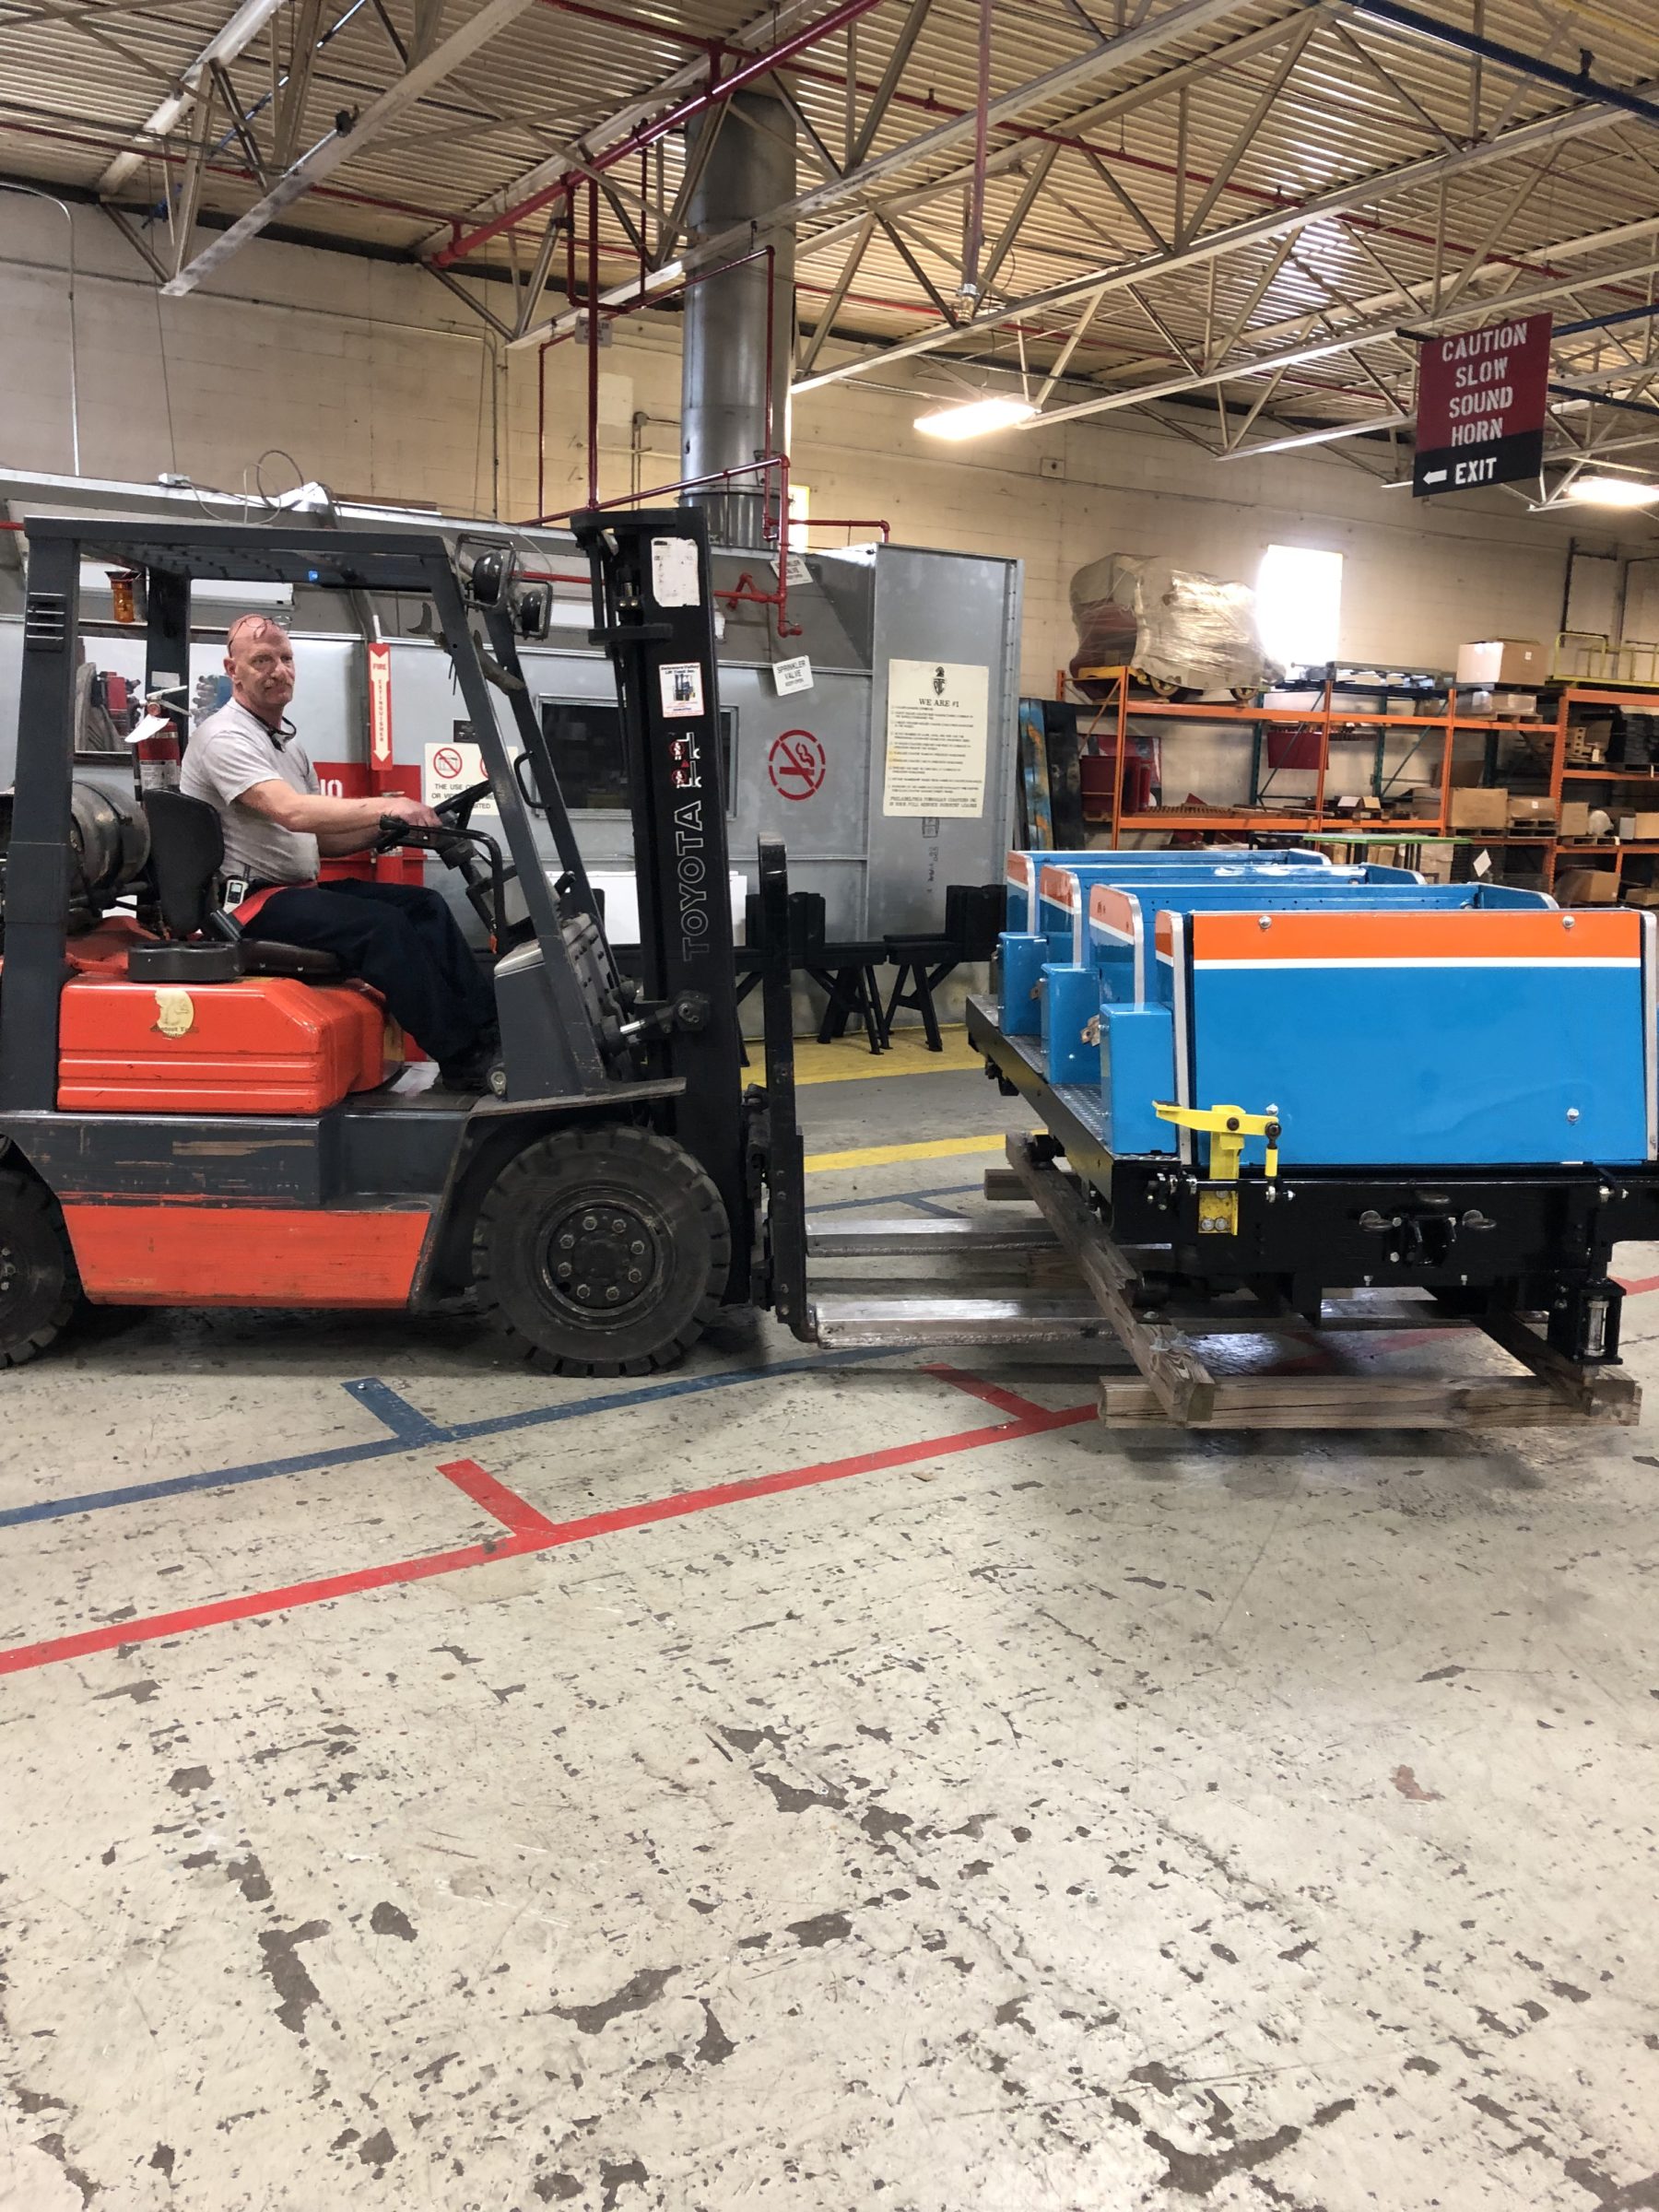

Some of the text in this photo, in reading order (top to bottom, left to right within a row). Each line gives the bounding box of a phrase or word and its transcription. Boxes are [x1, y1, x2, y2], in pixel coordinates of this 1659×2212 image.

[1441, 323, 1527, 361] CAUTION
[1455, 357, 1509, 388] SLOW
[1449, 386, 1513, 418] SOUND
[1451, 418, 1503, 447] HORN
[1454, 457, 1497, 485] EXIT
[777, 660, 806, 674] SPRINKLER
[784, 669, 802, 679] VALVE
[674, 800, 710, 961] TOYOTA
